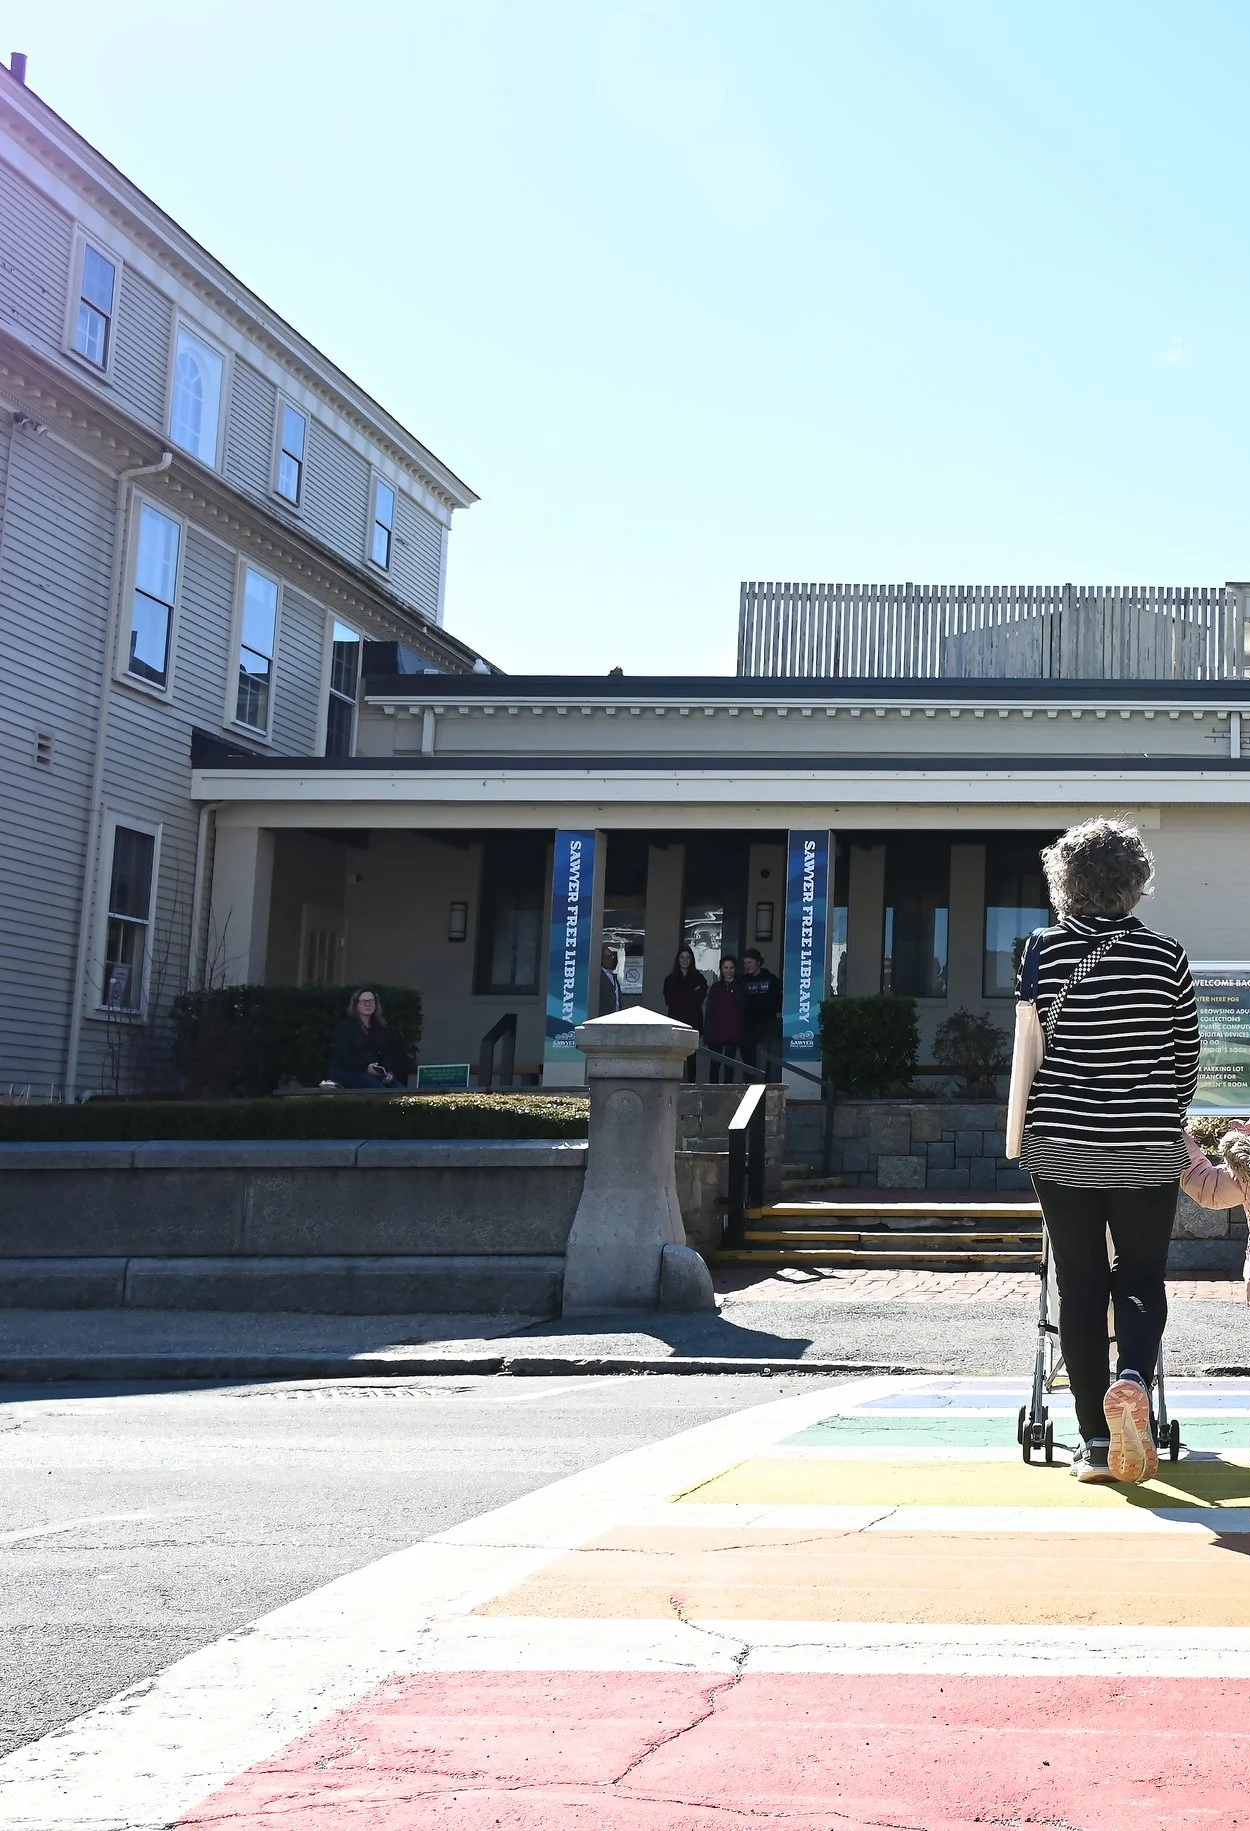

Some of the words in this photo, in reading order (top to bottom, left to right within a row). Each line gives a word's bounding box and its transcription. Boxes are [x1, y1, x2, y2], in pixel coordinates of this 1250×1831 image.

[567, 840, 582, 903] SAWYER
[802, 840, 816, 903] SAWYER
[565, 905, 579, 948] FREE
[801, 905, 814, 948] FREE
[561, 950, 577, 1023] LIBRARY
[799, 950, 812, 1023] LIBRARY
[1192, 979, 1234, 987] WELCOME
